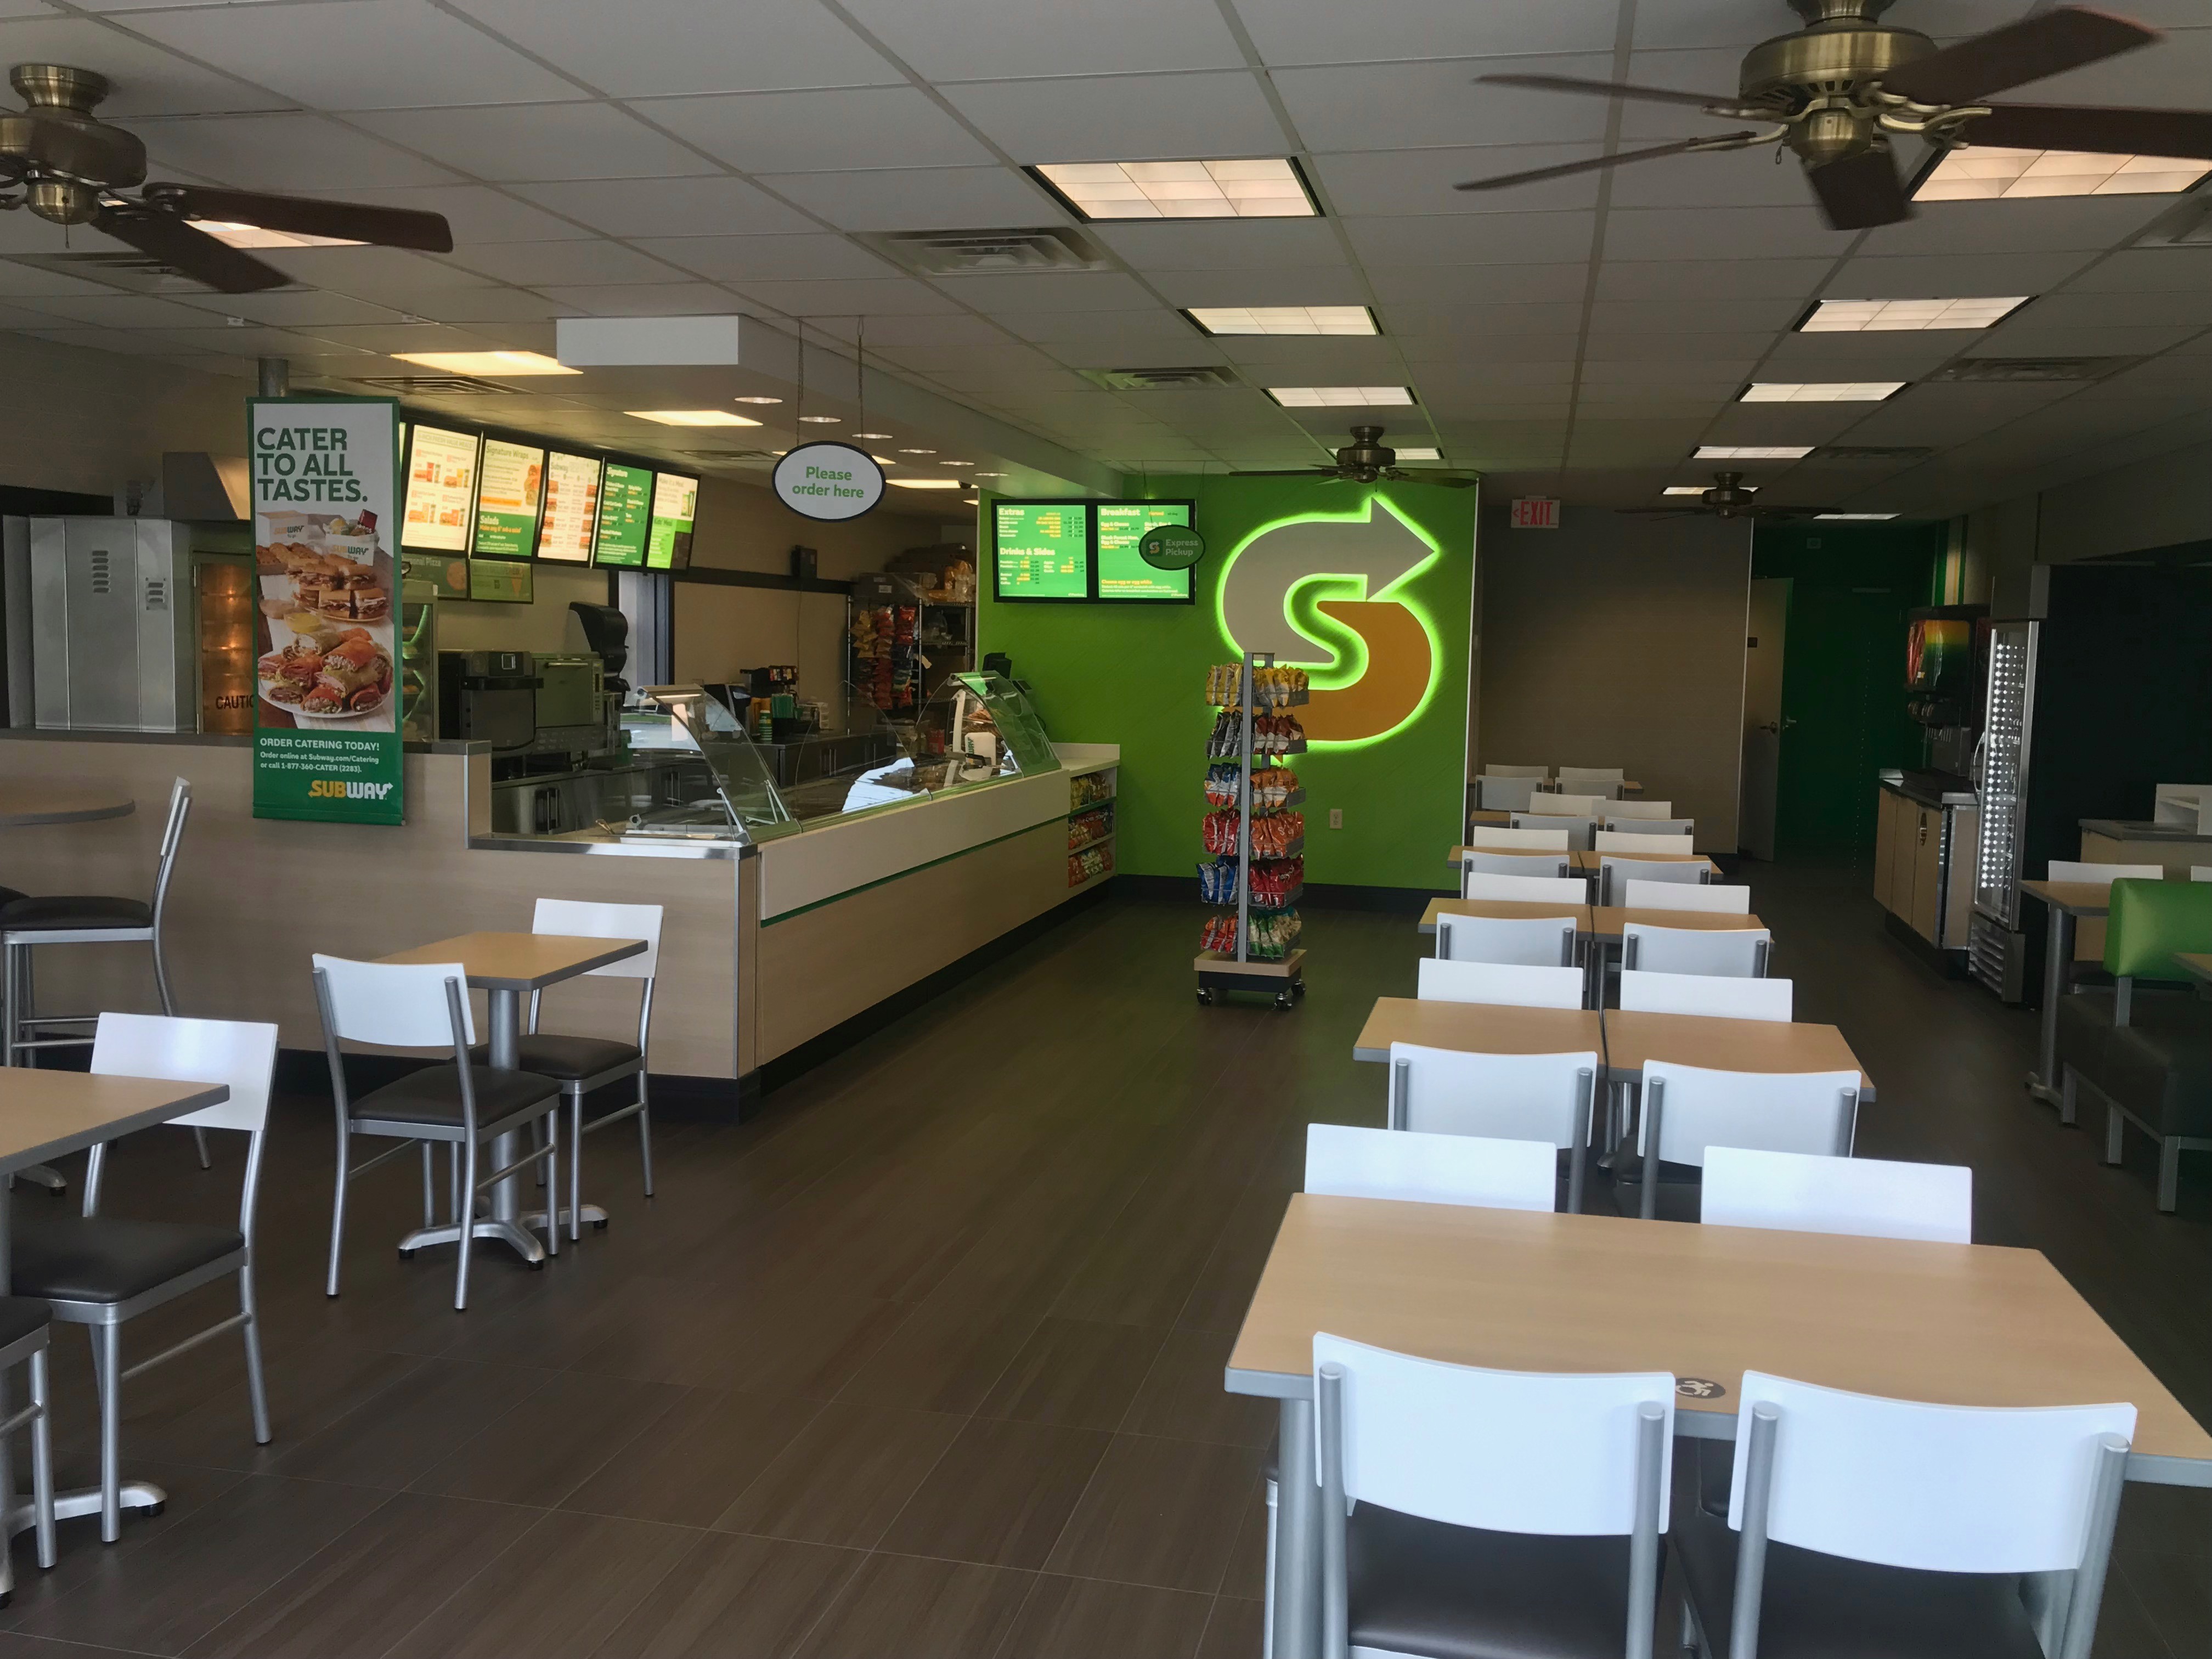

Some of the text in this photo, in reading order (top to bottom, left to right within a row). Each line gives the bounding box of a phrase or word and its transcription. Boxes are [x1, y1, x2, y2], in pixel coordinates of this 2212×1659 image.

[257, 427, 347, 450] CATER
[486, 445, 529, 459] Signature Wraps
[257, 453, 353, 476] TO ALL
[551, 462, 569, 473] Subway
[806, 466, 852, 481] Please
[257, 478, 368, 502] TASTES.
[792, 483, 864, 498] order here
[480, 515, 499, 525] Salads
[1520, 501, 1553, 525] EXIT
[274, 525, 304, 534] SUBWAY
[334, 544, 369, 555] SUBWAY
[1166, 549, 1193, 557] Pickup
[426, 557, 441, 567] Pizza
[260, 737, 379, 751] ORDER CATERING TODAY!
[309, 753, 379, 764] Subway.com/Catering
[281, 763, 338, 771] 1-877-360-CATER
[308, 780, 393, 800] SUBWAY
